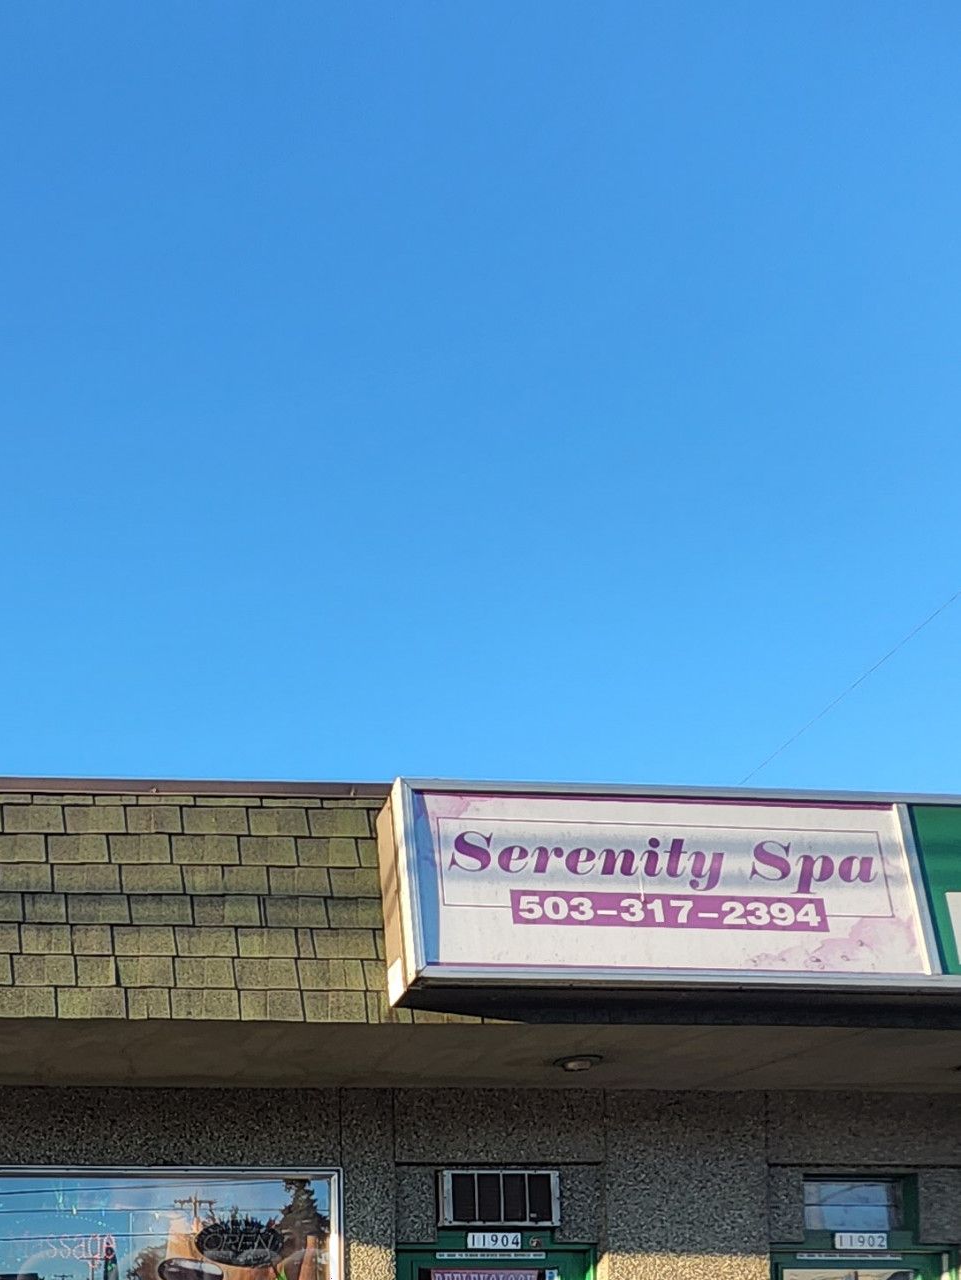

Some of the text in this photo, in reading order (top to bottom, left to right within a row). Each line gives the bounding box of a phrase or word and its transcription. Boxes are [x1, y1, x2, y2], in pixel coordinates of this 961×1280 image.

[448, 830, 880, 895] Serenity Spa
[518, 895, 821, 927] 503-317-2394
[472, 1234, 520, 1247] 11904
[840, 1235, 886, 1248] 11902
